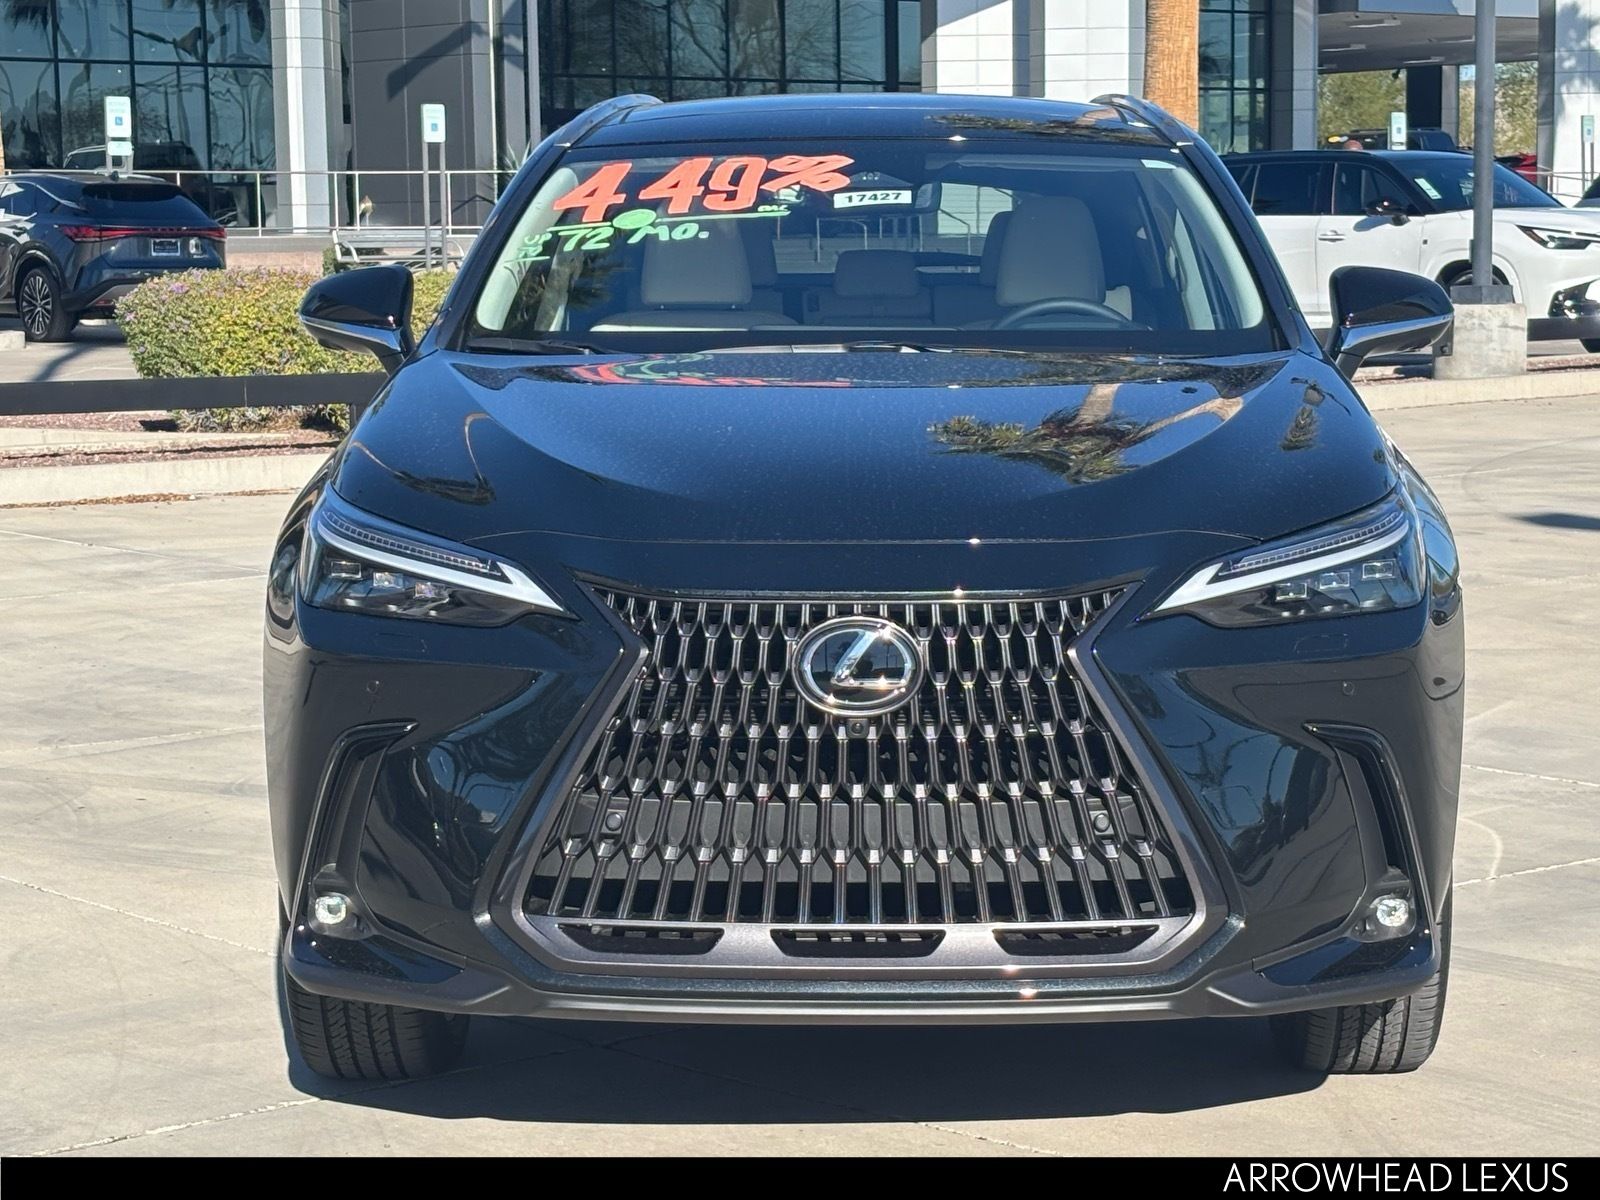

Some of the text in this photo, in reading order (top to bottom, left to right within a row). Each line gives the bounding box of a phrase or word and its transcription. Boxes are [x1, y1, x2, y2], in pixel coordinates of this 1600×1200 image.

[845, 192, 902, 204] 17427
[523, 232, 553, 245] UP
[558, 226, 615, 252] 72
